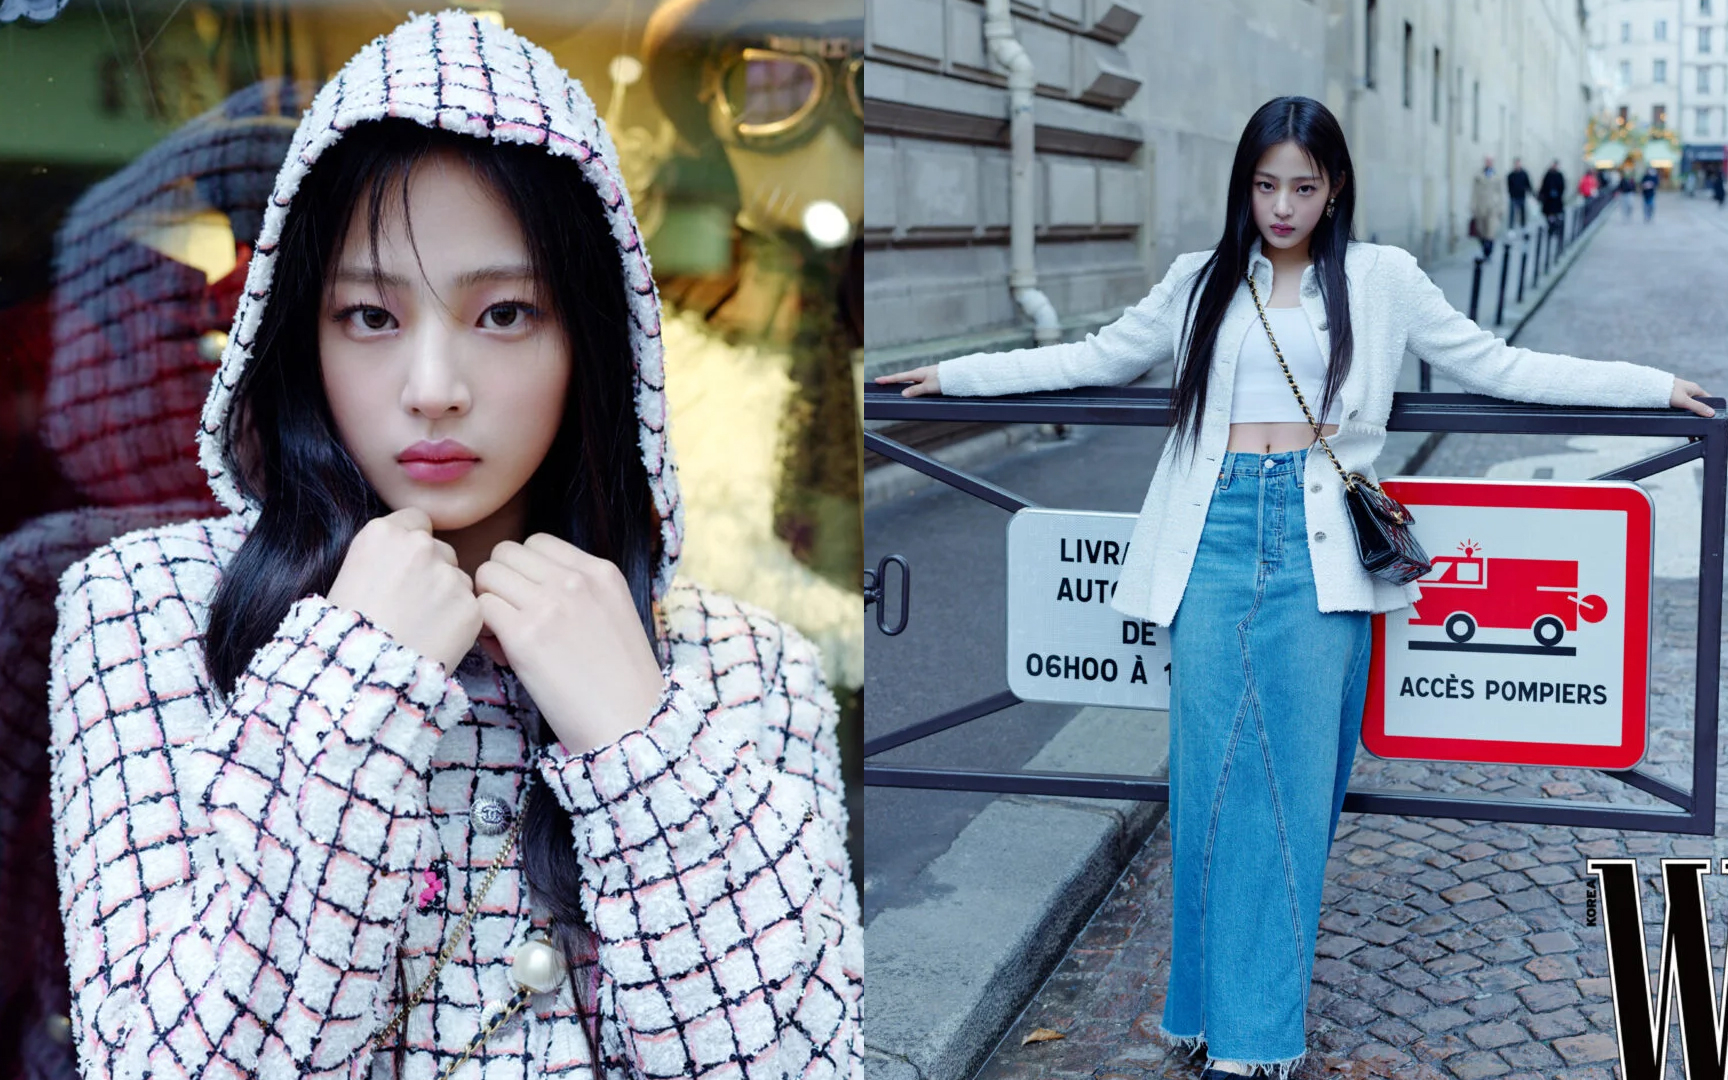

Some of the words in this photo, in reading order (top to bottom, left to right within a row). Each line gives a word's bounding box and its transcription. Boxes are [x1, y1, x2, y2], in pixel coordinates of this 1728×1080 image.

[1057, 577, 1118, 604] AUT
[1122, 621, 1157, 646] DE
[1026, 653, 1118, 682] 06H00
[1130, 655, 1148, 685] À
[1400, 673, 1475, 700] ACCÈS
[1485, 680, 1608, 705] POMPIERS
